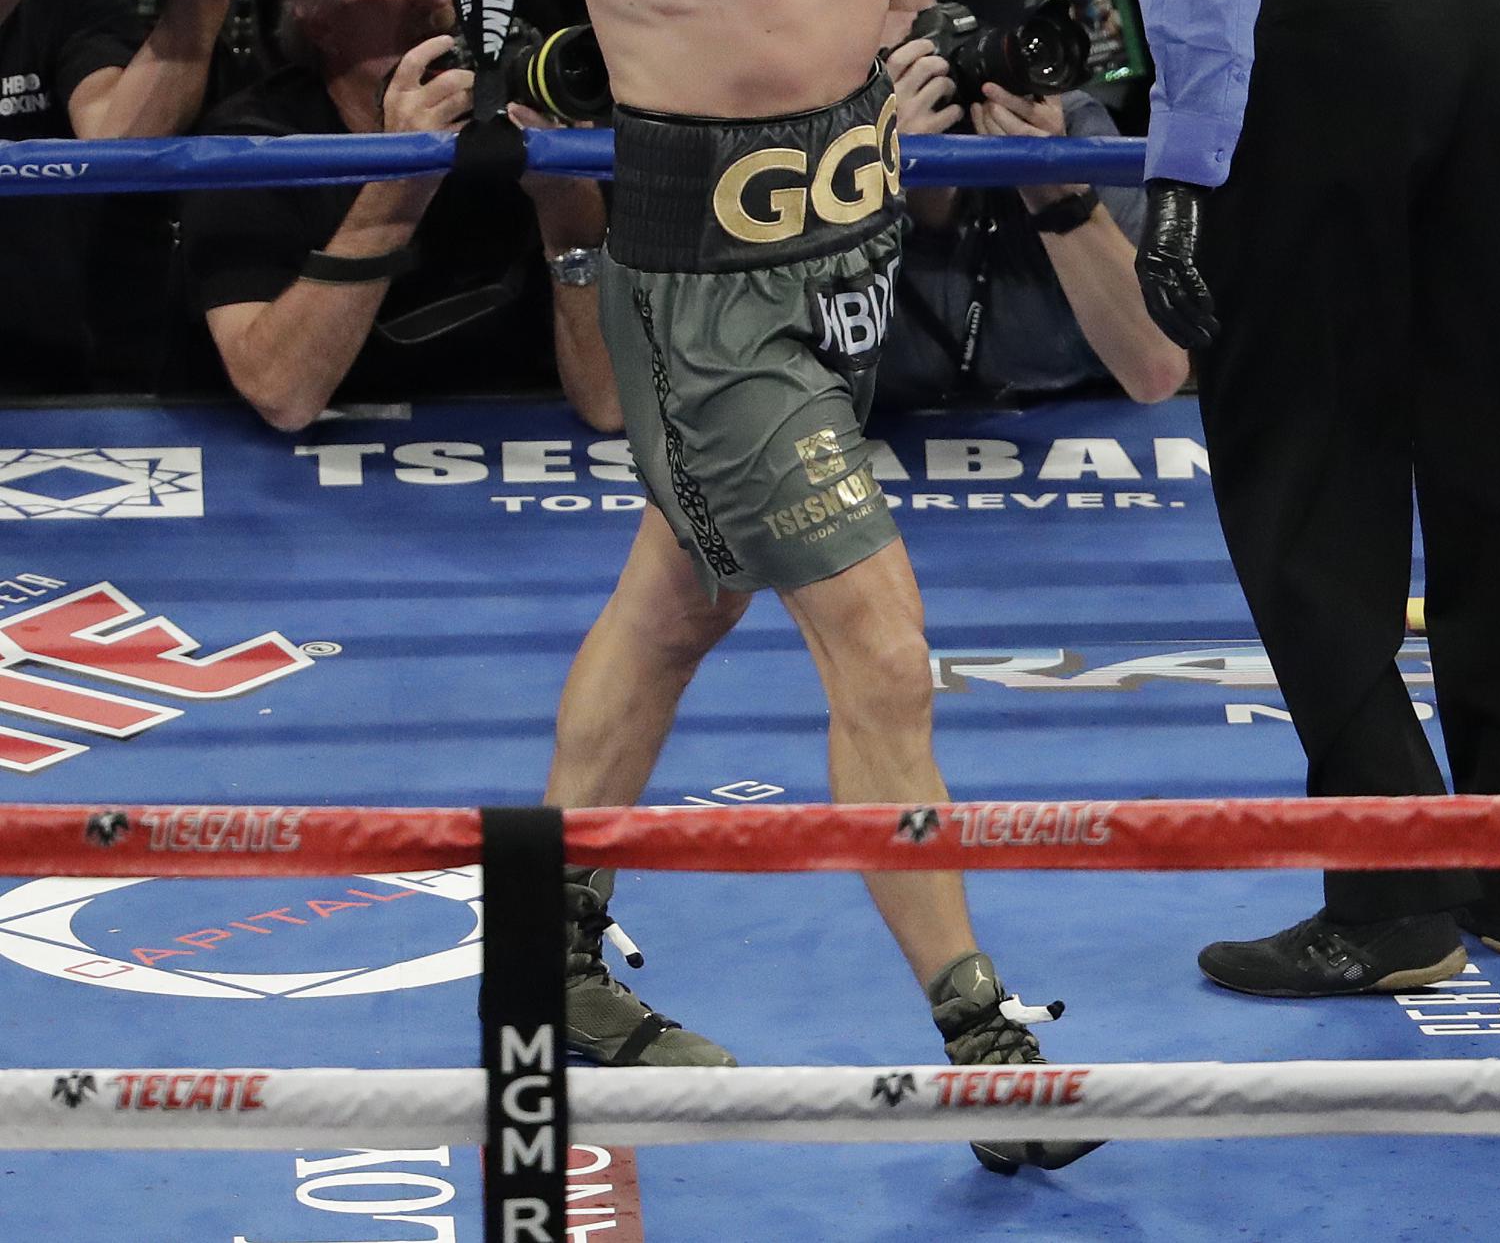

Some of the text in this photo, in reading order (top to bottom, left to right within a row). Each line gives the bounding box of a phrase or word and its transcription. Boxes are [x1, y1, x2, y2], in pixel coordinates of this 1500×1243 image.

[0, 93, 48, 115] OXIN
[2, 73, 40, 96] HBO
[713, 93, 900, 244] GGG
[140, 809, 304, 852] TECATE
[948, 801, 1115, 847] TECATE
[112, 1072, 270, 1111] TECATE
[502, 1023, 554, 1175] MGM
[925, 1069, 1092, 1108] TECATE
